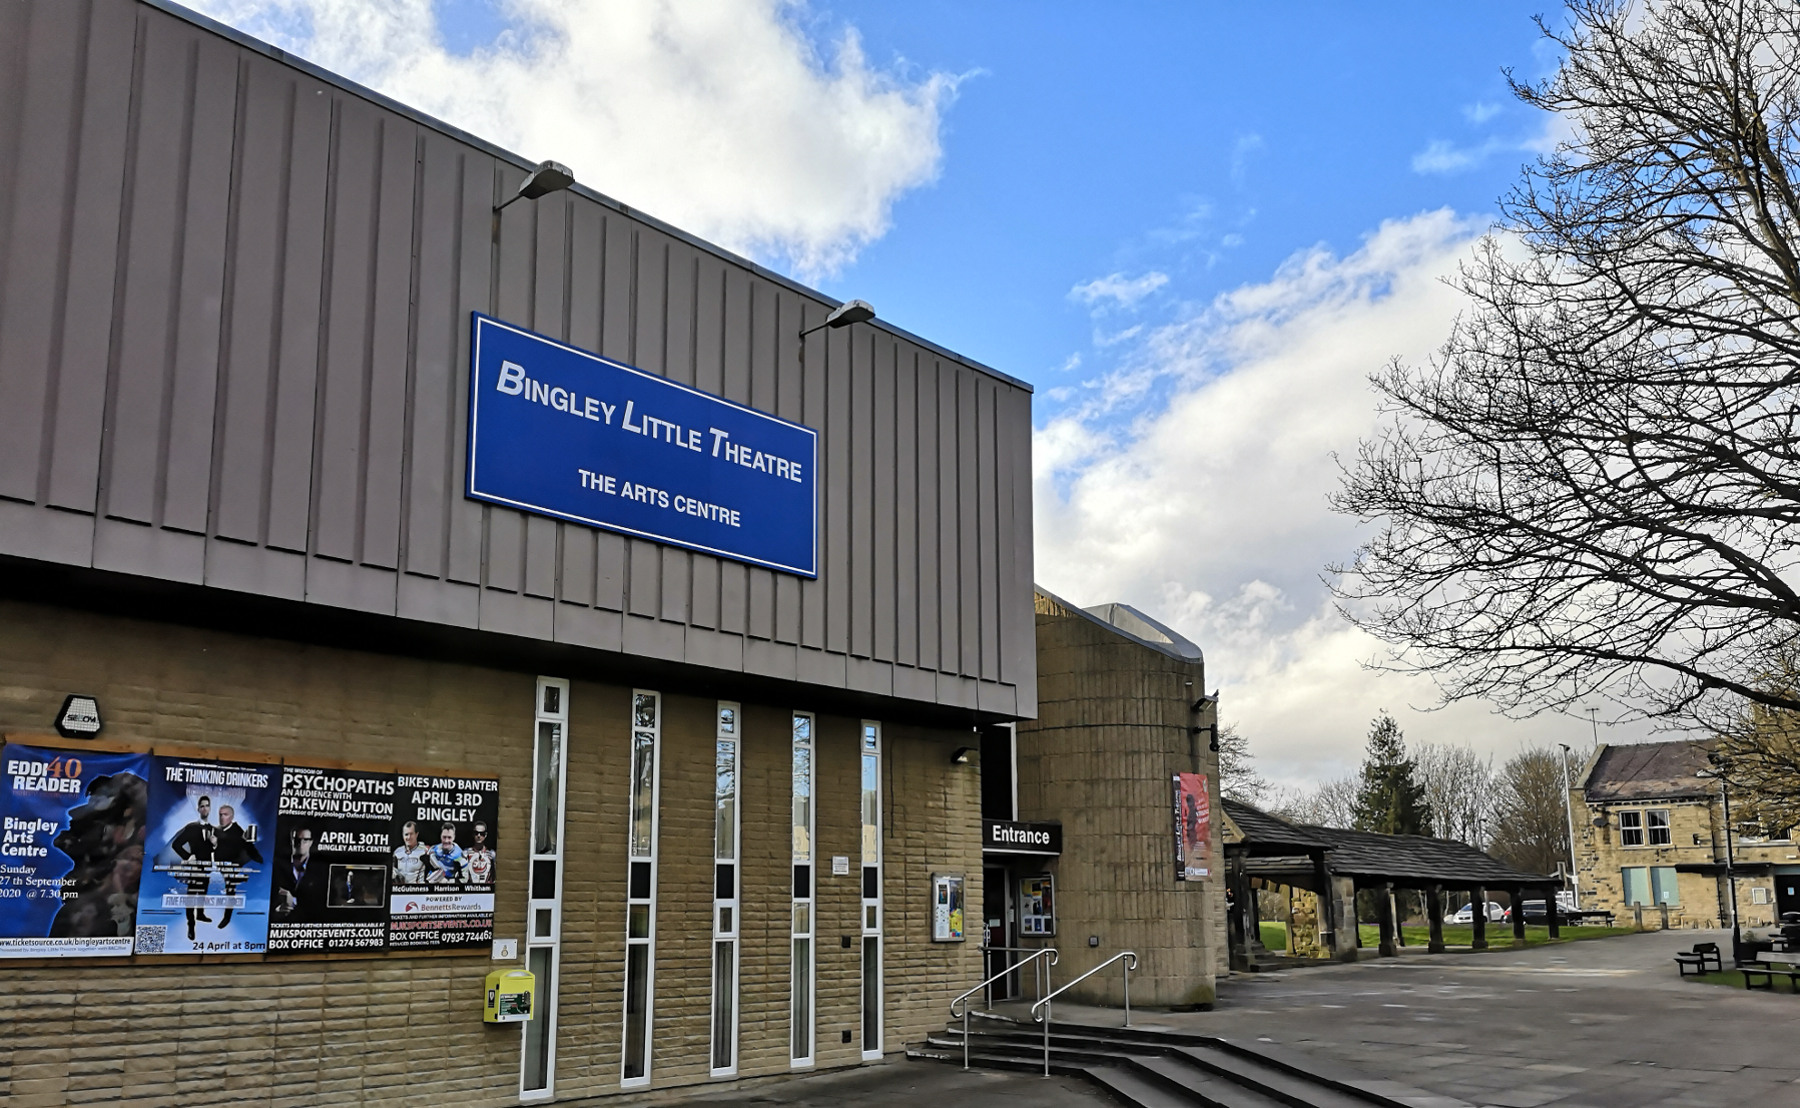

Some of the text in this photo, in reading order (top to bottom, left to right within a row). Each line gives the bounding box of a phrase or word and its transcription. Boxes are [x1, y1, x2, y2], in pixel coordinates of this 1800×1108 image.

[496, 360, 802, 483] BINGLEY LITTLE THEATRE
[578, 469, 741, 528] THE ARTS CENTRE
[165, 766, 184, 782] THE
[185, 768, 226, 785] THINKING
[226, 771, 269, 788] DRINKERS
[397, 776, 499, 792] BIKES AND BANTER
[13, 775, 81, 794] READER
[282, 773, 395, 796] PSYCHOPATHS
[281, 789, 352, 800] AN AUDIENCE WITH
[411, 791, 483, 807] APRIL 3RD
[342, 800, 394, 815] DUTTON
[313, 811, 346, 819] psychology
[346, 811, 366, 819] Oxford
[366, 813, 393, 821] University
[417, 807, 477, 823] BINGLEY
[4, 816, 58, 836] Bingley
[3, 830, 34, 844] Arts
[320, 831, 389, 846] APRIL 30TH
[992, 825, 1050, 844] Entrance
[1, 843, 48, 857] Centre
[317, 843, 347, 851] BINGLEY
[0, 864, 37, 876] Sunday
[12, 876, 23, 886] th
[25, 876, 77, 888] September
[40, 889, 61, 899] 7.30
[62, 890, 79, 900] pm
[269, 928, 385, 939] MJKSPORTSEVENTS.CO.UK
[389, 930, 493, 943] BOX OFFICE 07932 724462
[192, 942, 266, 952] 24 April at 8pm
[269, 938, 384, 949] BOX OFFICE 01274 567983
